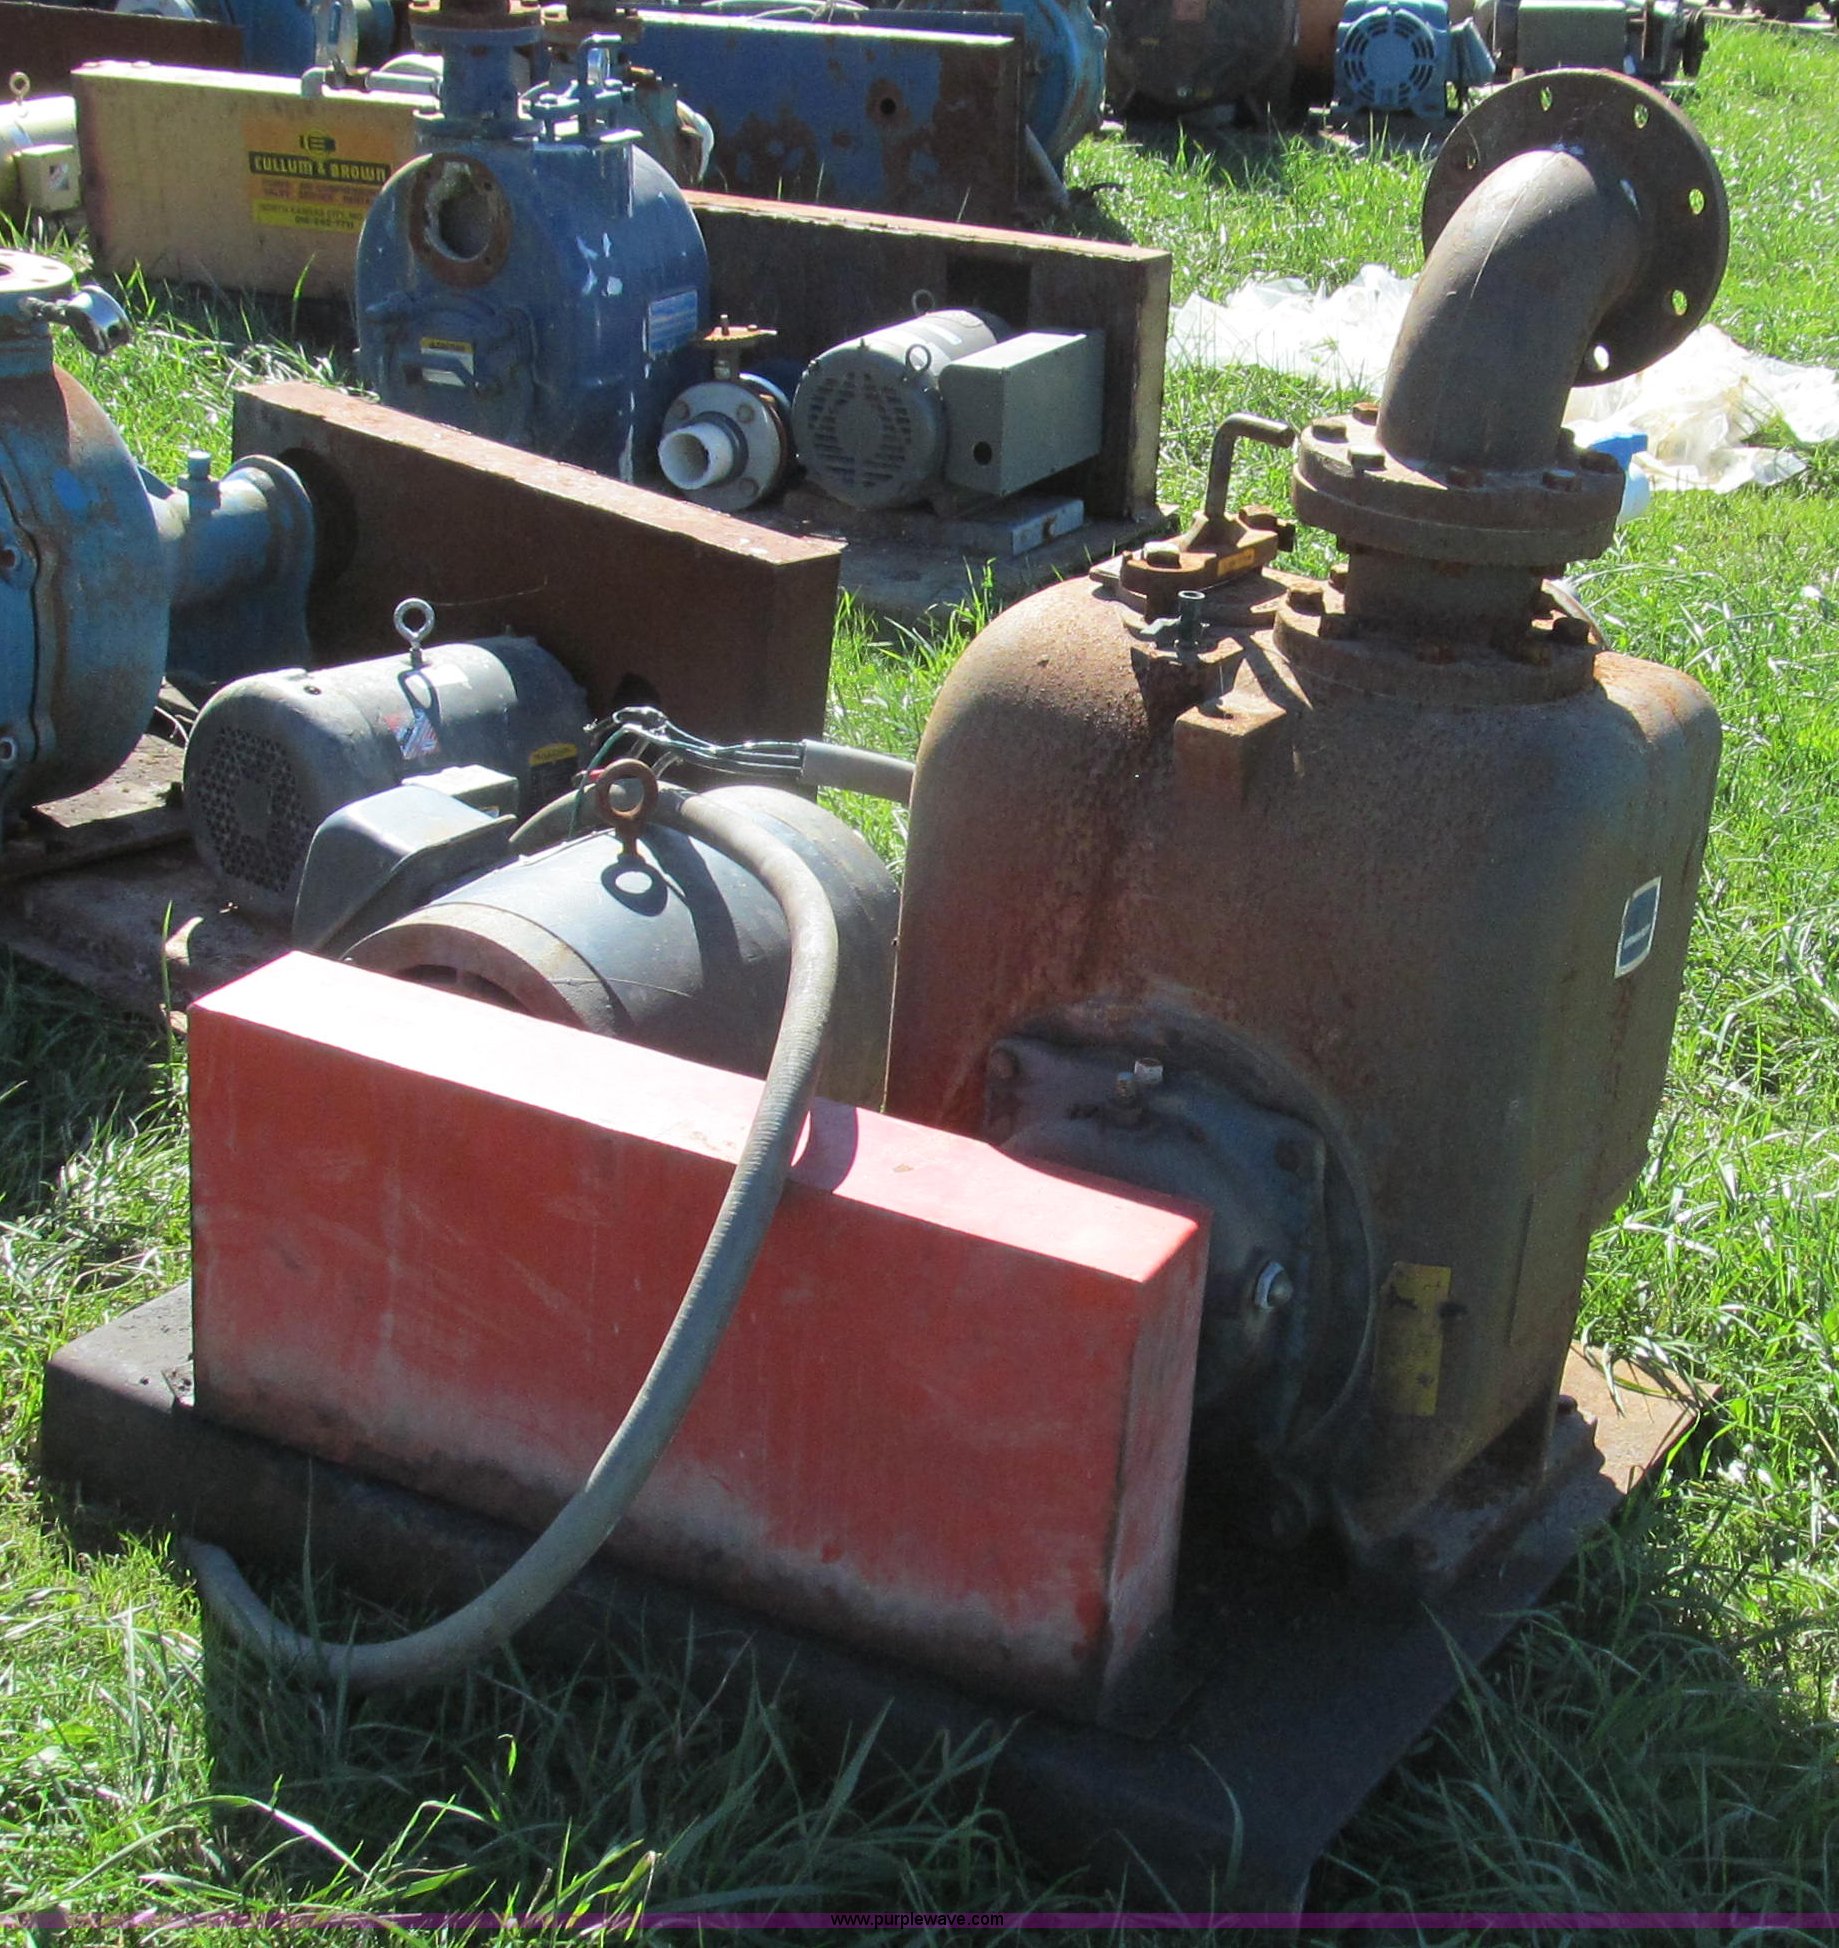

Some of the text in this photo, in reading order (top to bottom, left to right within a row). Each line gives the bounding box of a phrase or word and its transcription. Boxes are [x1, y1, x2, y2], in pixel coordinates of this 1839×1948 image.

[253, 155, 386, 181] CULLUM & BROWN
